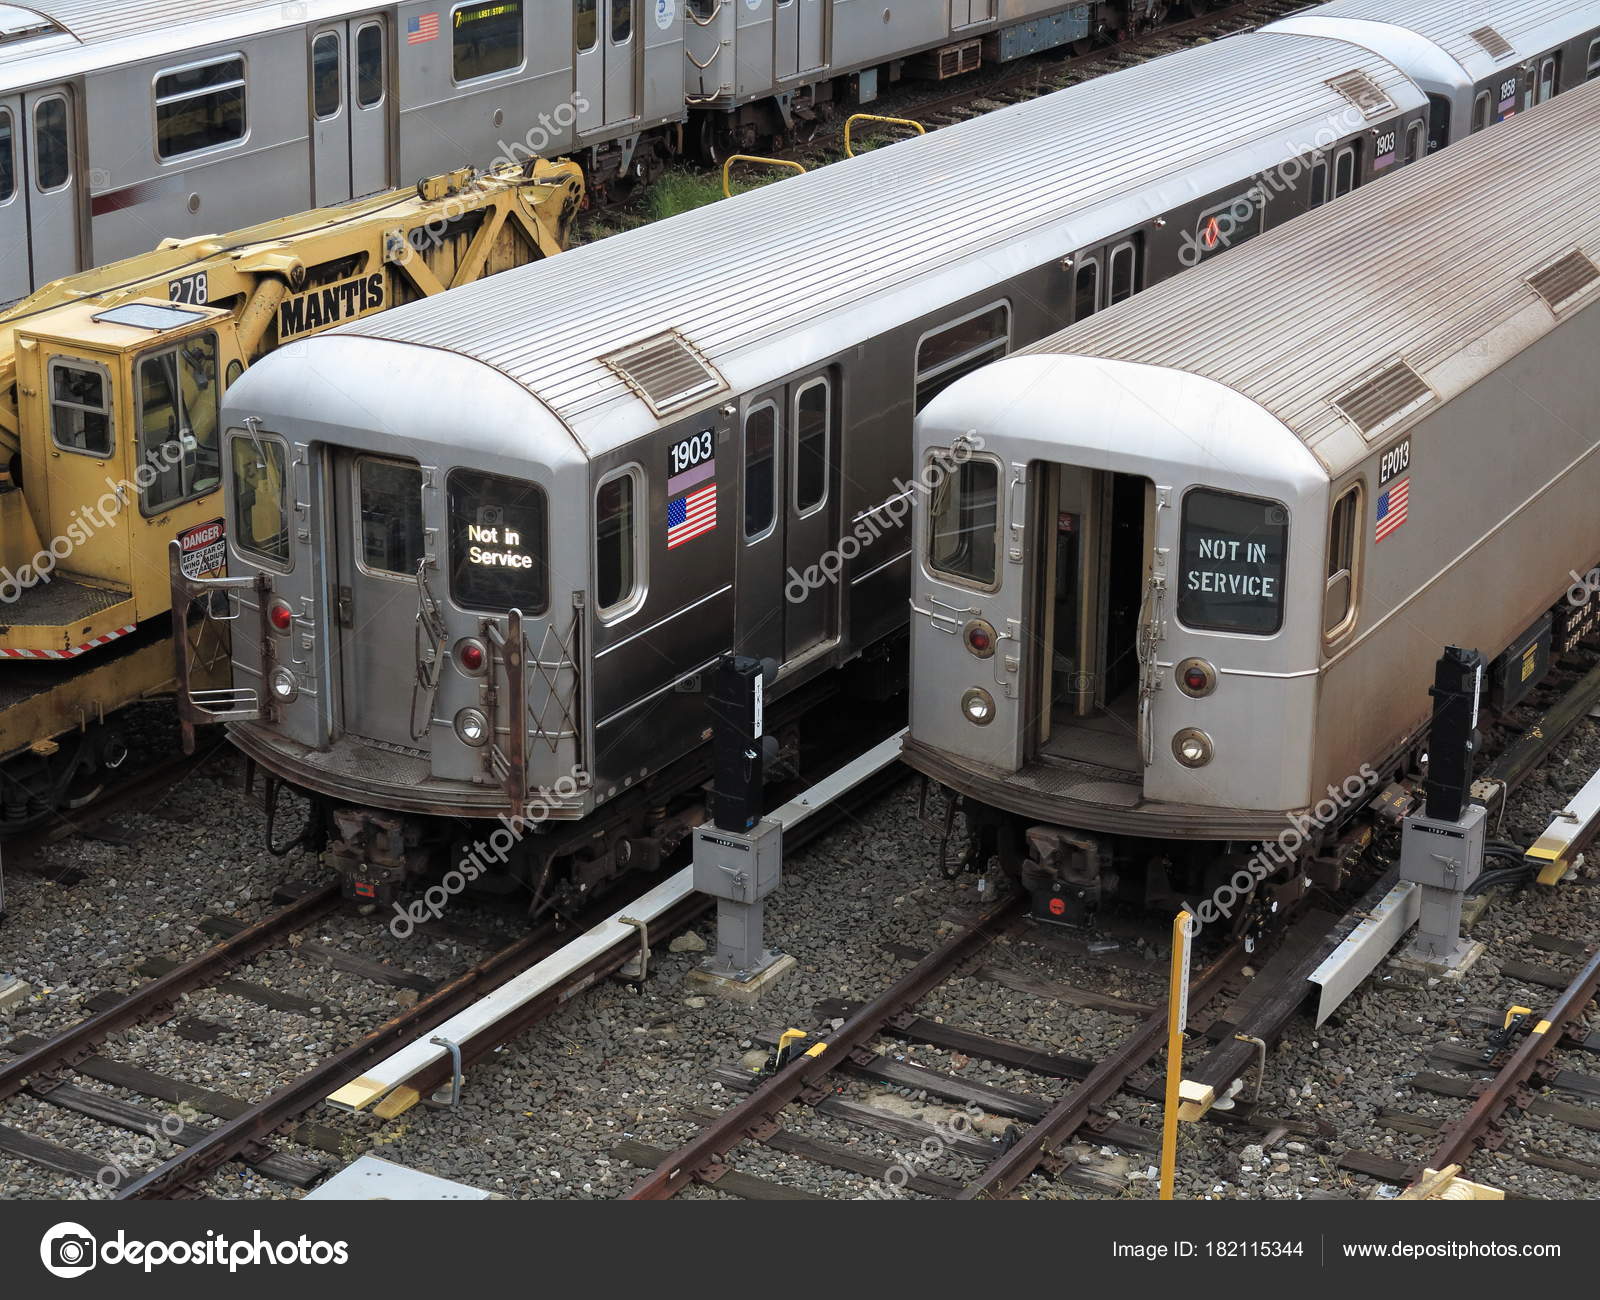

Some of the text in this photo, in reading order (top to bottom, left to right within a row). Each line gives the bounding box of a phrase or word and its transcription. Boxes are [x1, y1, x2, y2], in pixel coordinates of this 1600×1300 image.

[1501, 78, 1516, 101] 1958
[1376, 131, 1395, 156] 1903
[170, 274, 207, 304] 278
[281, 273, 383, 338] MANTIS
[671, 431, 712, 473] 1903
[1380, 440, 1410, 484] EP013
[183, 525, 220, 550] DANGER
[468, 524, 520, 545] Not in
[203, 550, 224, 562] ADIUS
[469, 546, 533, 569] Service
[1199, 538, 1266, 564] NOT IN
[1187, 570, 1275, 598] SERVICE
